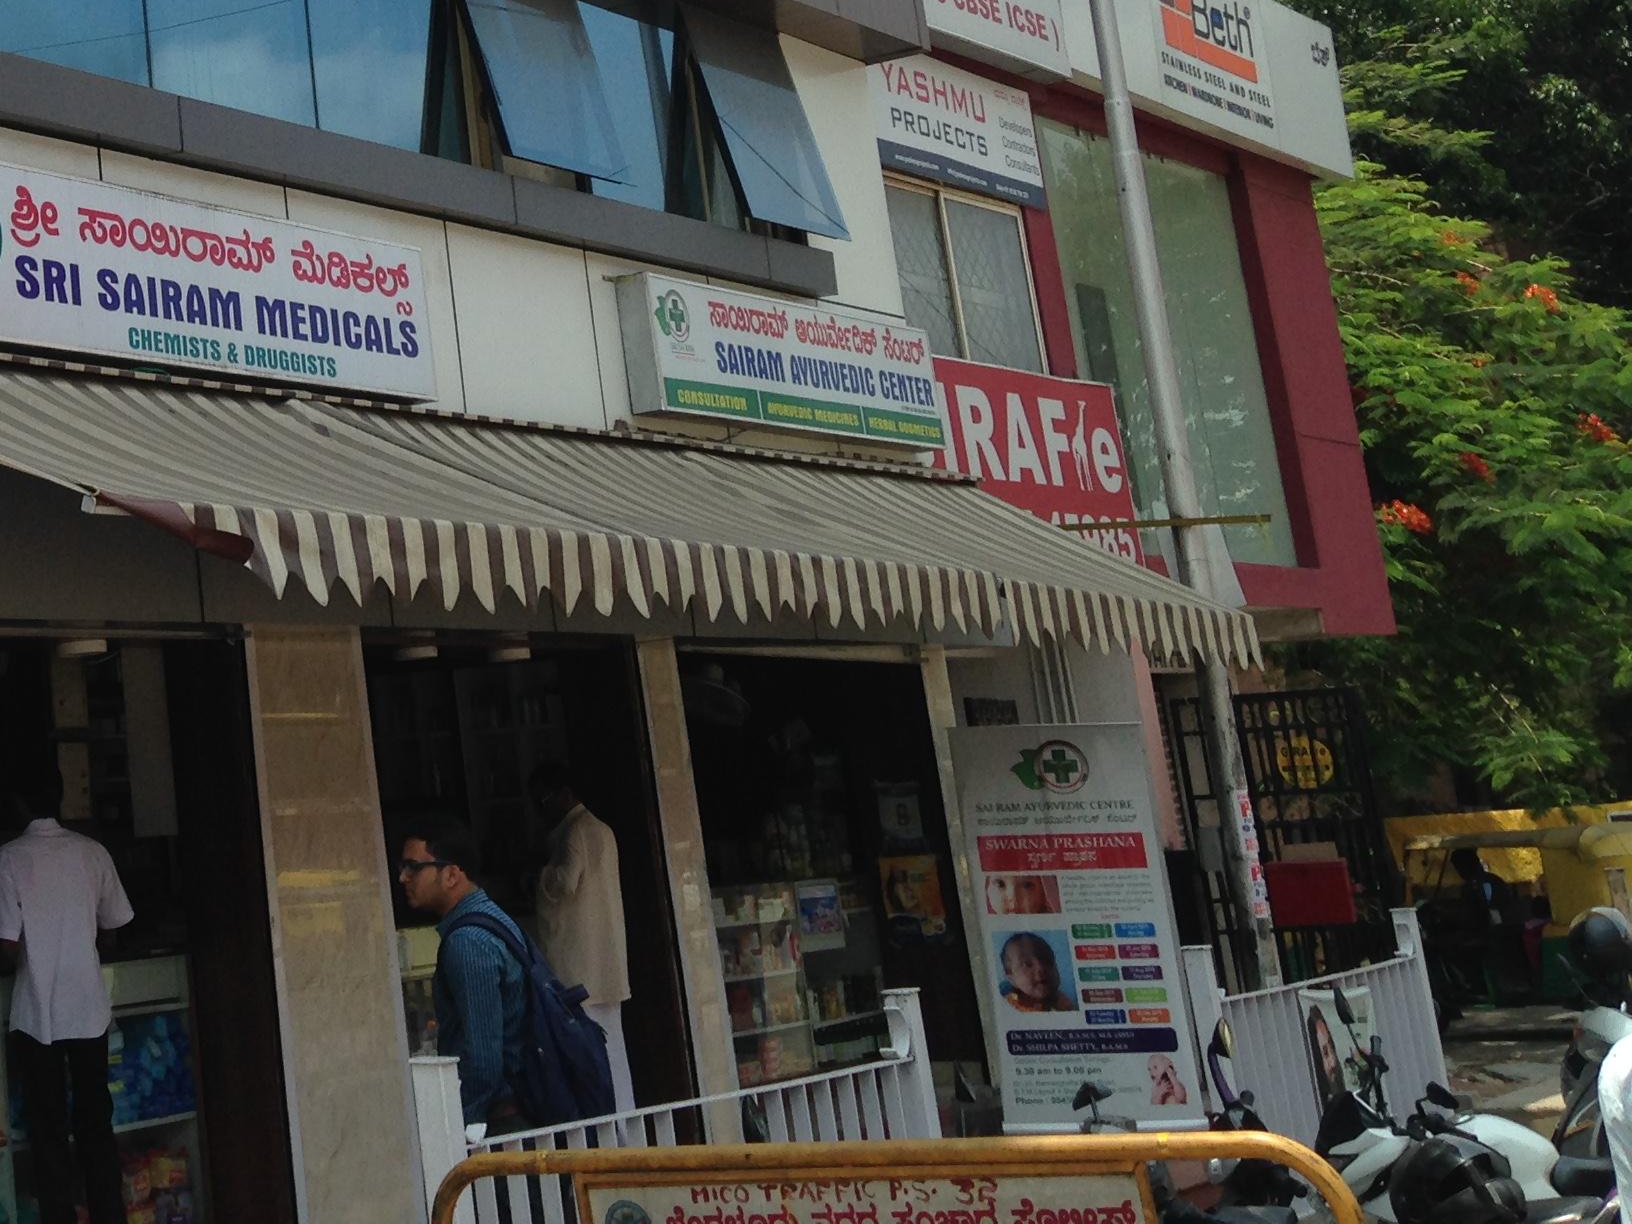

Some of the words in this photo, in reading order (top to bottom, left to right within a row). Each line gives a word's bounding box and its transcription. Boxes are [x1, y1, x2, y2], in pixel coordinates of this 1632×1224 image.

[1005, 1, 1049, 41] ICSE
[880, 63, 986, 123] YASHMU
[1161, 51, 1202, 80] STAINLESS
[1204, 71, 1226, 92] STEEL
[1229, 81, 1246, 98] AND
[1249, 90, 1271, 108] STEEL
[890, 107, 988, 156] PROJECTS
[10, 184, 60, 248] ಶ್ರೀ
[78, 207, 276, 274] ಸಾಯಿರಾಮ್
[291, 240, 414, 316] ಮೆಡಿಕಲ್ಸ್
[15, 255, 82, 307] SRI
[98, 268, 243, 330] SAIRAM
[255, 295, 420, 358] MEDICALS
[128, 327, 221, 364] CHEMISTS
[226, 342, 240, 364] &
[244, 344, 338, 378] DRUGGISTS
[715, 341, 786, 383] SAIRAM
[790, 354, 876, 397] AYURVEDIC
[879, 369, 935, 407] CENTER
[677, 388, 748, 410] CONSULTATION
[768, 402, 813, 419] AYURVEDIC
[816, 409, 859, 426] MEDICINES
[1024, 800, 1086, 811] AYURVEDIC
[1089, 799, 1134, 810] CENTRE
[985, 839, 1049, 850] SWARNA
[1054, 836, 1135, 849] PRASHANA
[691, 1184, 749, 1204] MICO
[757, 1180, 876, 1203] TRAFFIC
